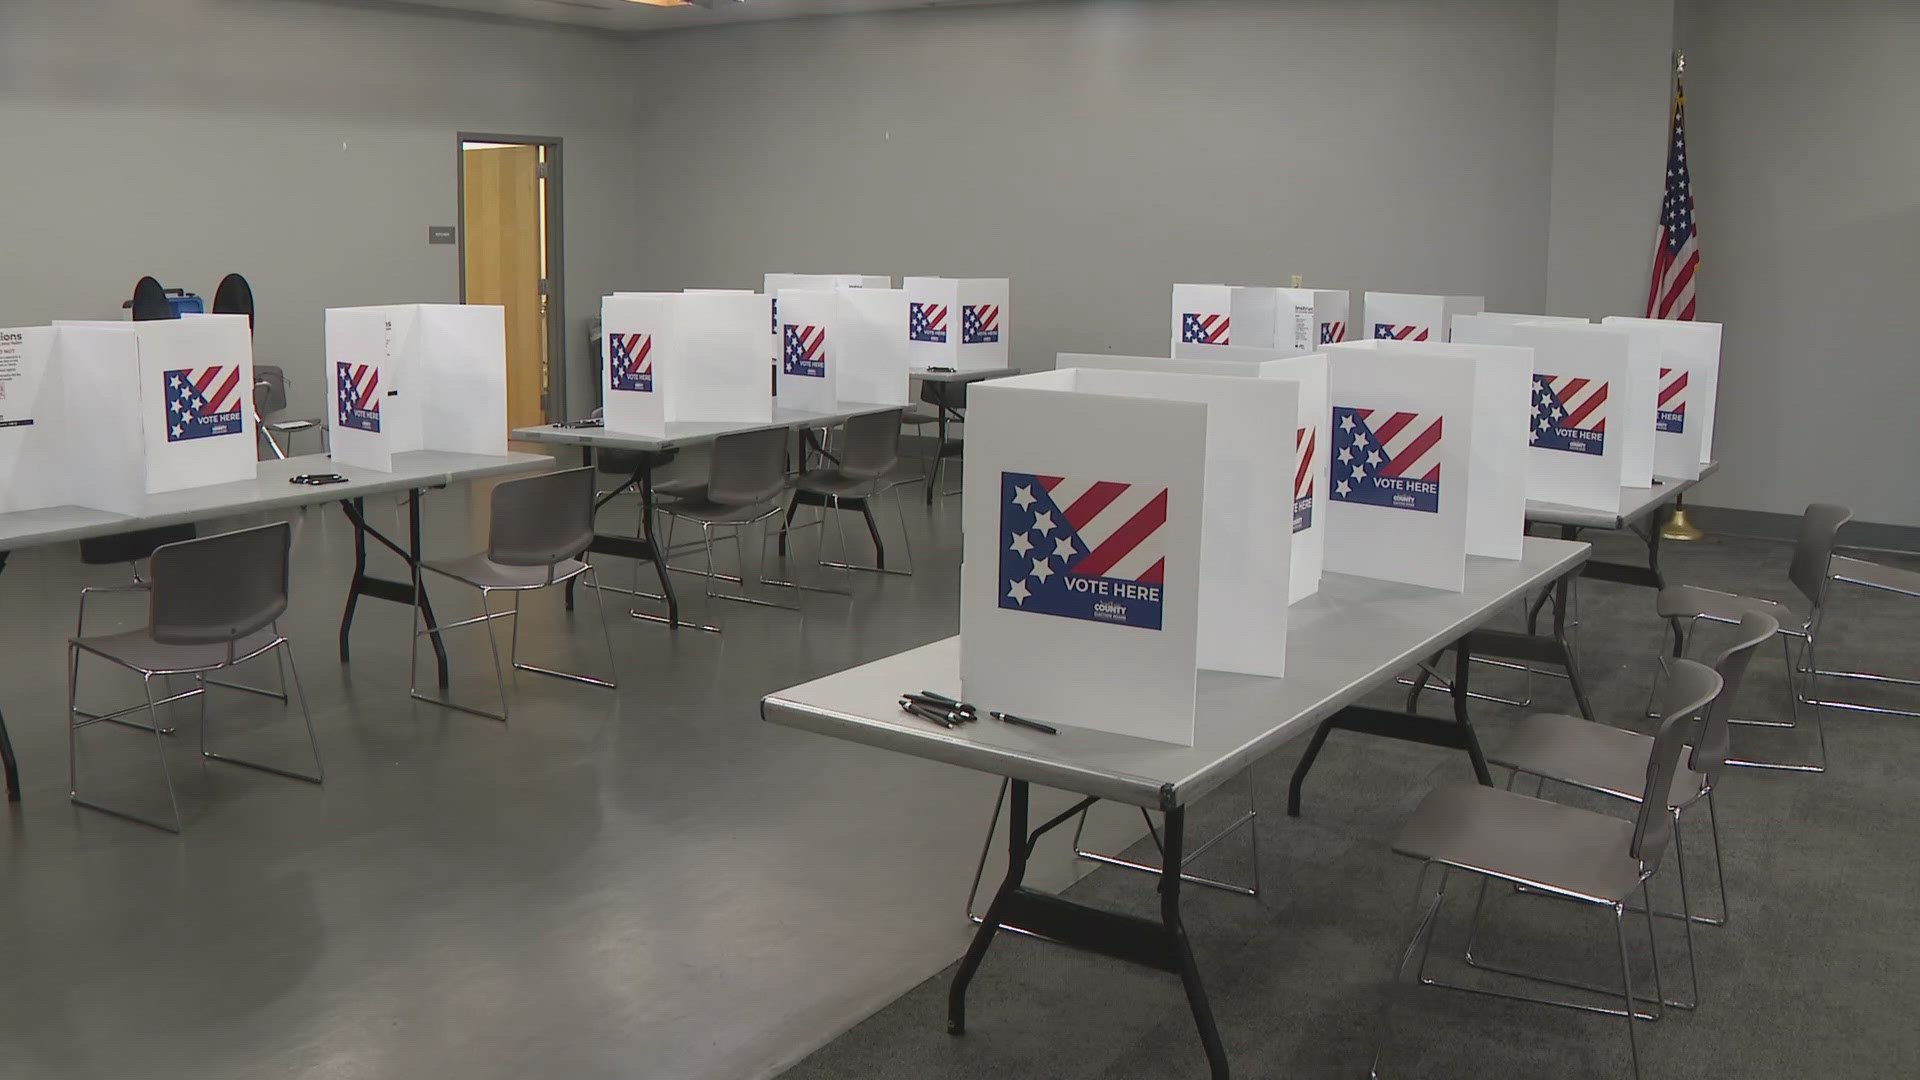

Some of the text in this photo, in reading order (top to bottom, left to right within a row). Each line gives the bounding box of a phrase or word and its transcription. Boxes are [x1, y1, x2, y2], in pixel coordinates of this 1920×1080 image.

[627, 373, 652, 382] VOTE HERE
[197, 412, 241, 425] VOTE HERE
[354, 410, 380, 421] VOTE HERE
[1661, 412, 1683, 422] HERE
[1555, 427, 1603, 442] VOTE HERE
[1373, 477, 1438, 494] VOTE HERE
[1063, 576, 1160, 603] VOTE HERE
[1094, 603, 1127, 615] COUNTY
